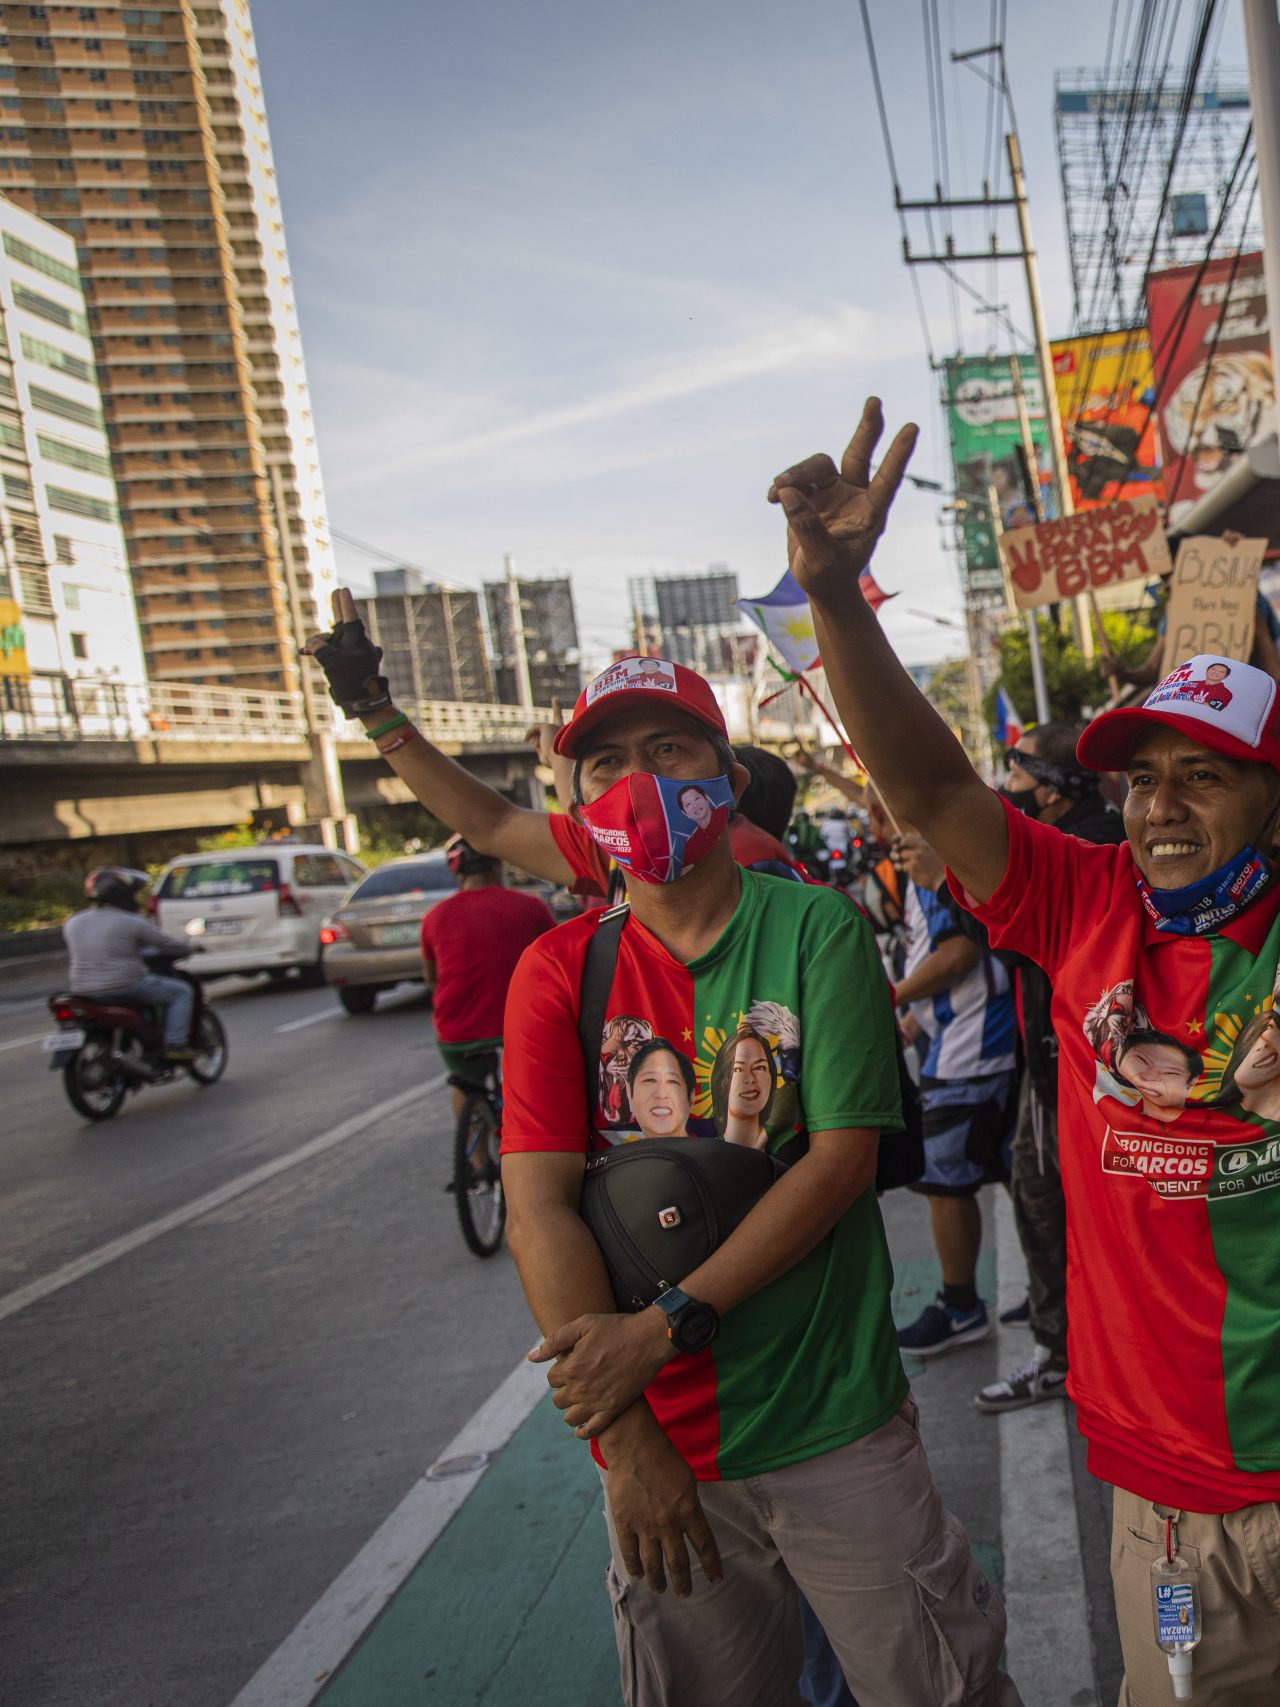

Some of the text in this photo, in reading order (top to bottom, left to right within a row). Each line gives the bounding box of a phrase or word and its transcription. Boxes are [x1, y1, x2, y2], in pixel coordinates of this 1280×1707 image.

[1056, 542, 1148, 597] BBM
[594, 668, 629, 692] BBM
[1210, 699, 1223, 709] #7
[1193, 902, 1236, 925] UNITED
[1120, 1138, 1209, 1156] BONGBONG
[1228, 1151, 1248, 1171] 4
[1219, 1178, 1245, 1193] FOR
[1158, 1587, 1171, 1598] #1
[1160, 1626, 1193, 1635] MARZAN
